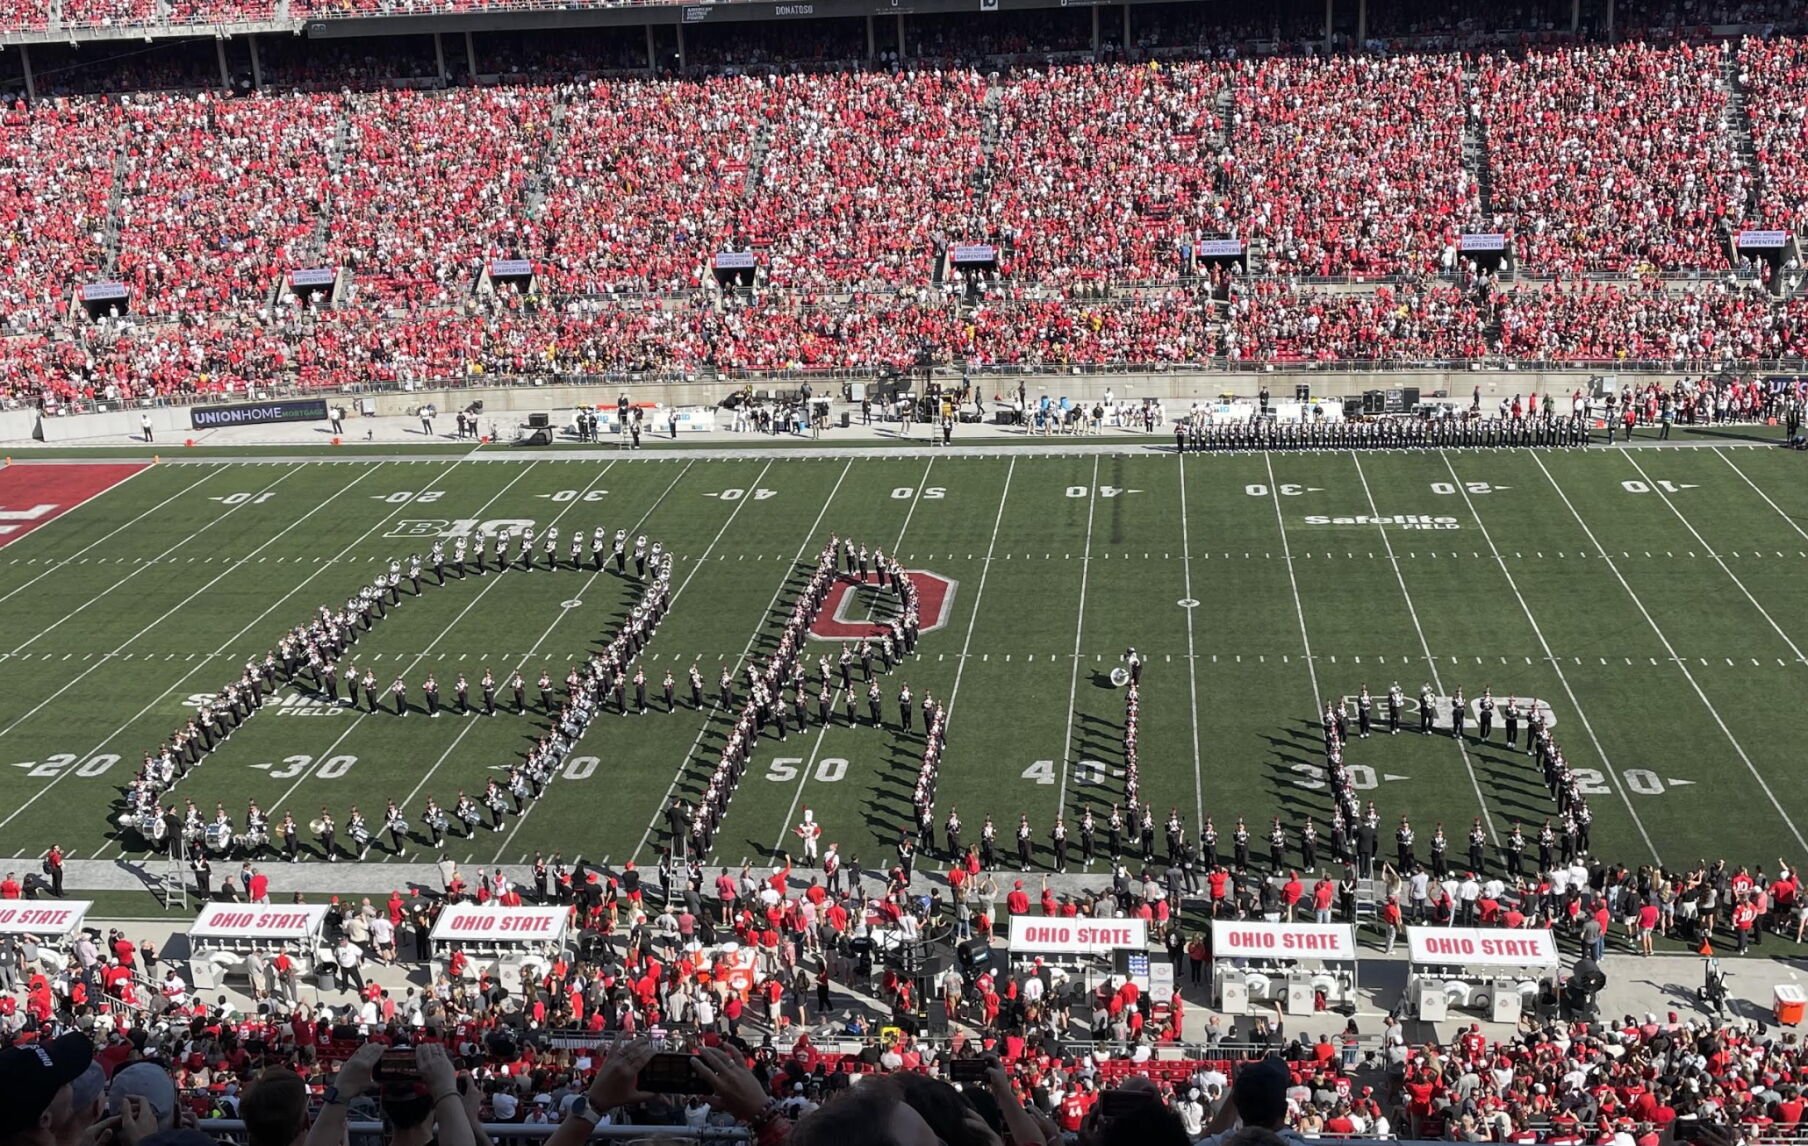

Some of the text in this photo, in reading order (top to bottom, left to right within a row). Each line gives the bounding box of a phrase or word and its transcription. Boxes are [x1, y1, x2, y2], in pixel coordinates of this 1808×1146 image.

[1304, 514, 1458, 525] Safelite
[276, 707, 344, 716] FIELD
[27, 753, 122, 778] 20
[268, 754, 359, 779] 30
[765, 757, 850, 782] 50
[1021, 760, 1106, 785] 40
[1290, 763, 1379, 789] 30
[1568, 768, 1666, 795] 20
[1736, 881, 1749, 892] 10
[17, 909, 72, 924] STATE
[209, 912, 309, 929] OHIO STATE
[450, 915, 554, 931] OHIO STATE
[1741, 910, 1753, 921] 10
[1025, 926, 1132, 944] OHIO STATE
[1228, 931, 1340, 950] OHIO STATE
[1425, 937, 1542, 956] OHIO STATE
[456, 1025, 466, 1036] 12
[1471, 1038, 1479, 1050] 5
[1069, 1105, 1083, 1117] 44
